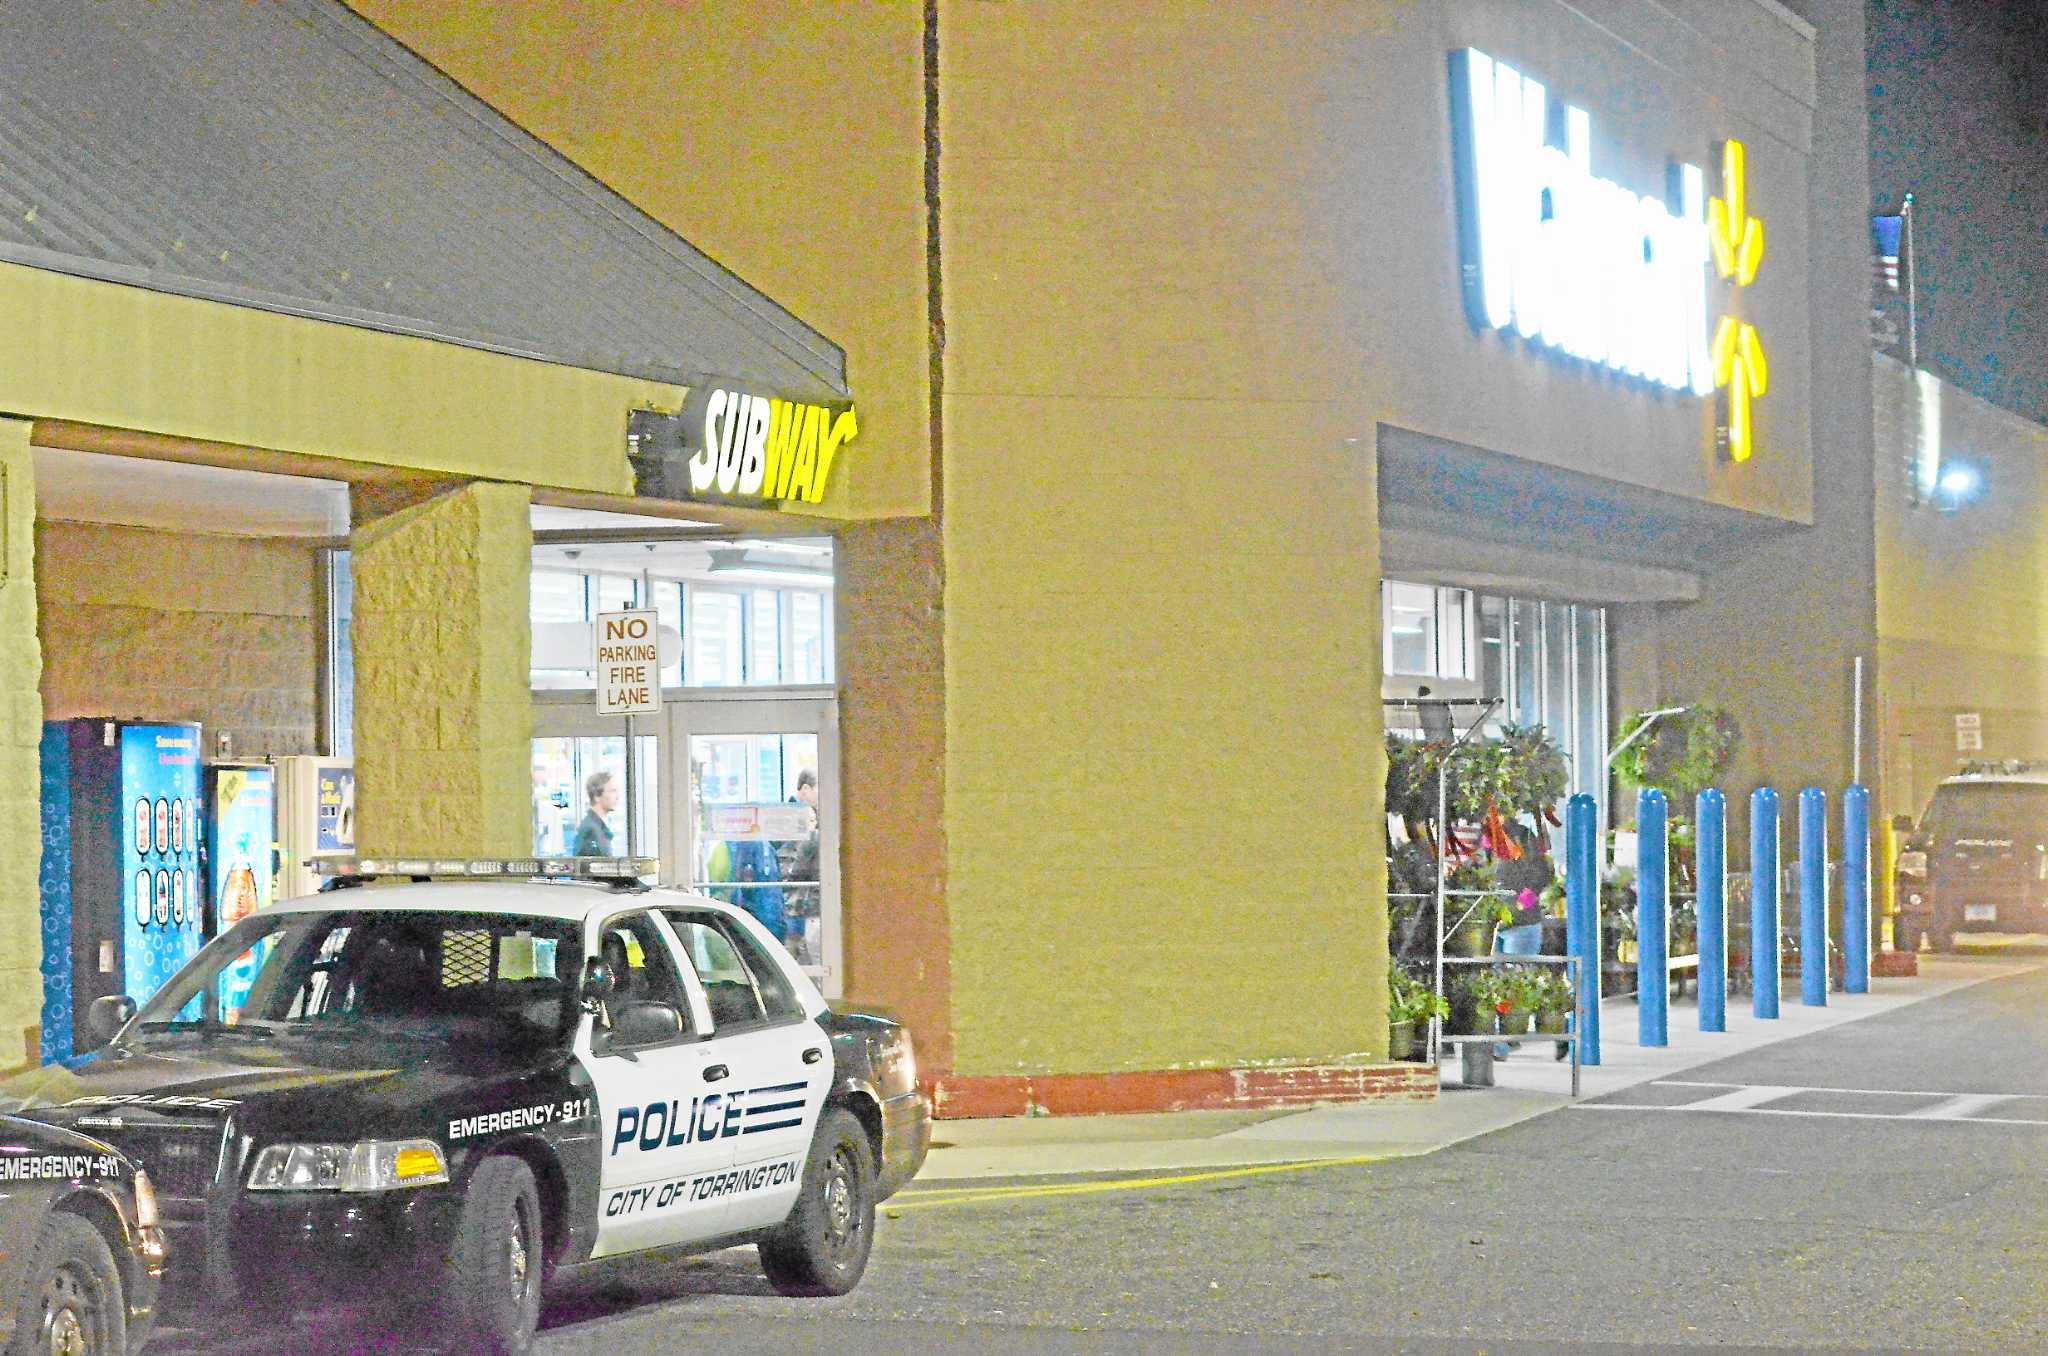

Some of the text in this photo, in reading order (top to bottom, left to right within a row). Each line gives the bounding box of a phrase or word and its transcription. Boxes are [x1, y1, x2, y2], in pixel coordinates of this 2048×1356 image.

[689, 388, 858, 504] SUBWAY
[607, 618, 648, 640] NO
[599, 644, 656, 662] PARKING
[610, 665, 646, 684] FIRE
[607, 687, 649, 705] LANE
[449, 1098, 590, 1139] EMERGENCY-911
[611, 1090, 745, 1156] POLICE
[606, 1159, 801, 1217] CITY OF TORRINGTON
